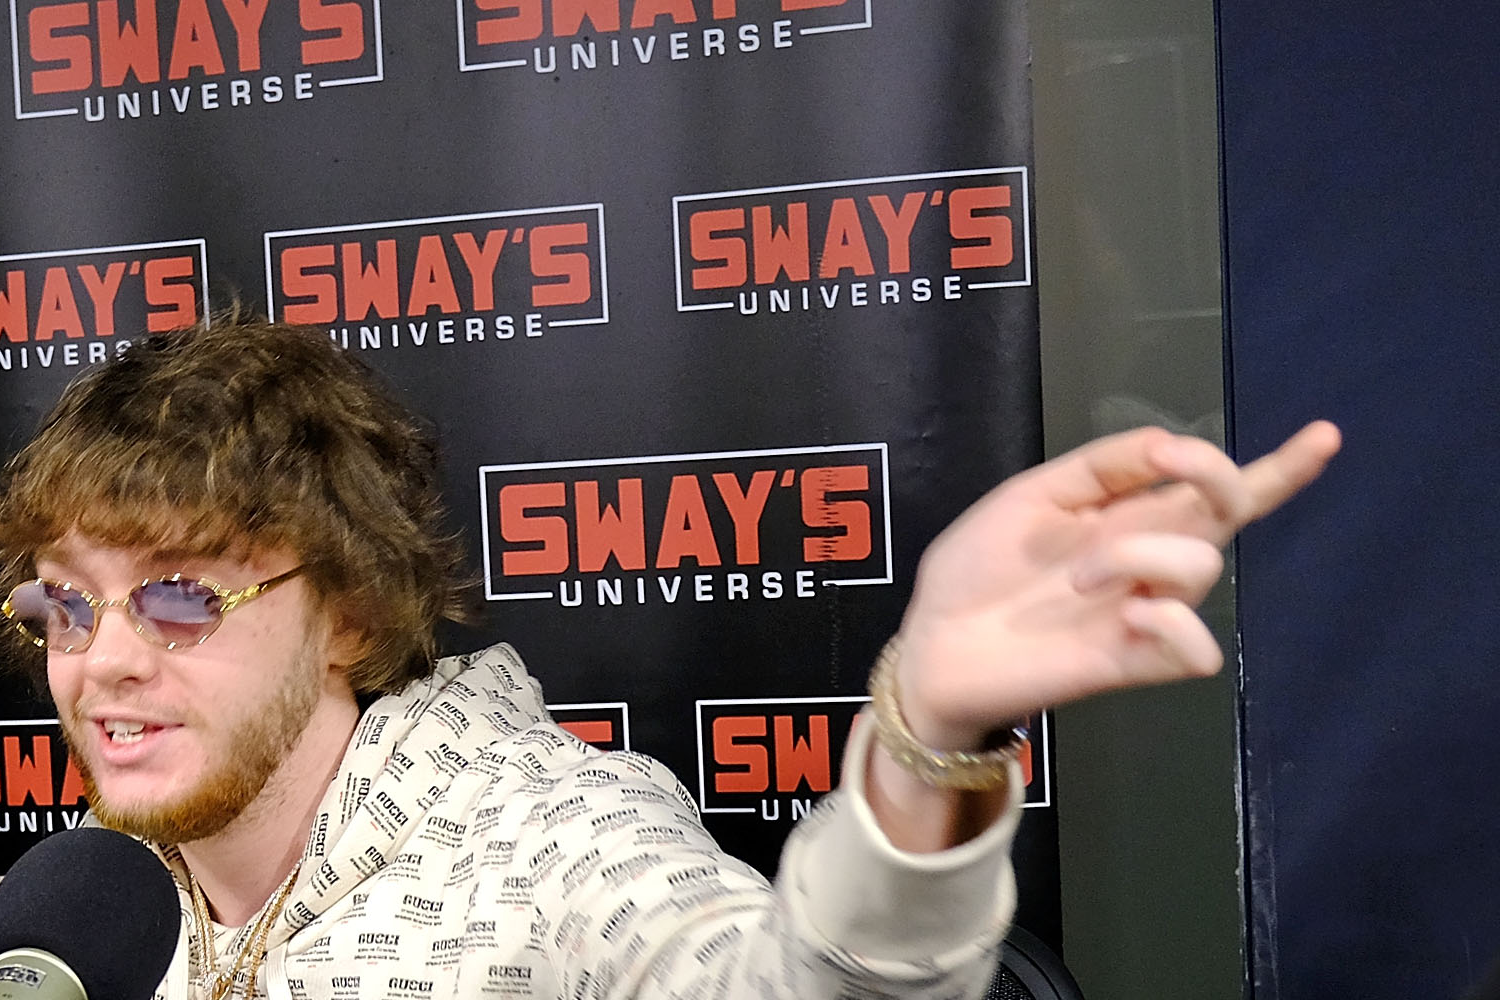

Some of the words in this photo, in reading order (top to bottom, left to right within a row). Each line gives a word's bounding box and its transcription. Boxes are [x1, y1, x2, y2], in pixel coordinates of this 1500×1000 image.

[533, 20, 794, 73] UNIVERSE
[84, 73, 314, 122] UNIVERSE
[689, 185, 1013, 290] SWAY'S
[281, 222, 592, 326] SWAY'S
[739, 276, 962, 315] UNIVERSE
[499, 464, 872, 576] SWAY'S
[559, 570, 817, 607] UNIVERSE
[369, 715, 389, 745] GUCCI
[376, 791, 409, 826] GUCCI
[314, 812, 329, 857] GUCCI
